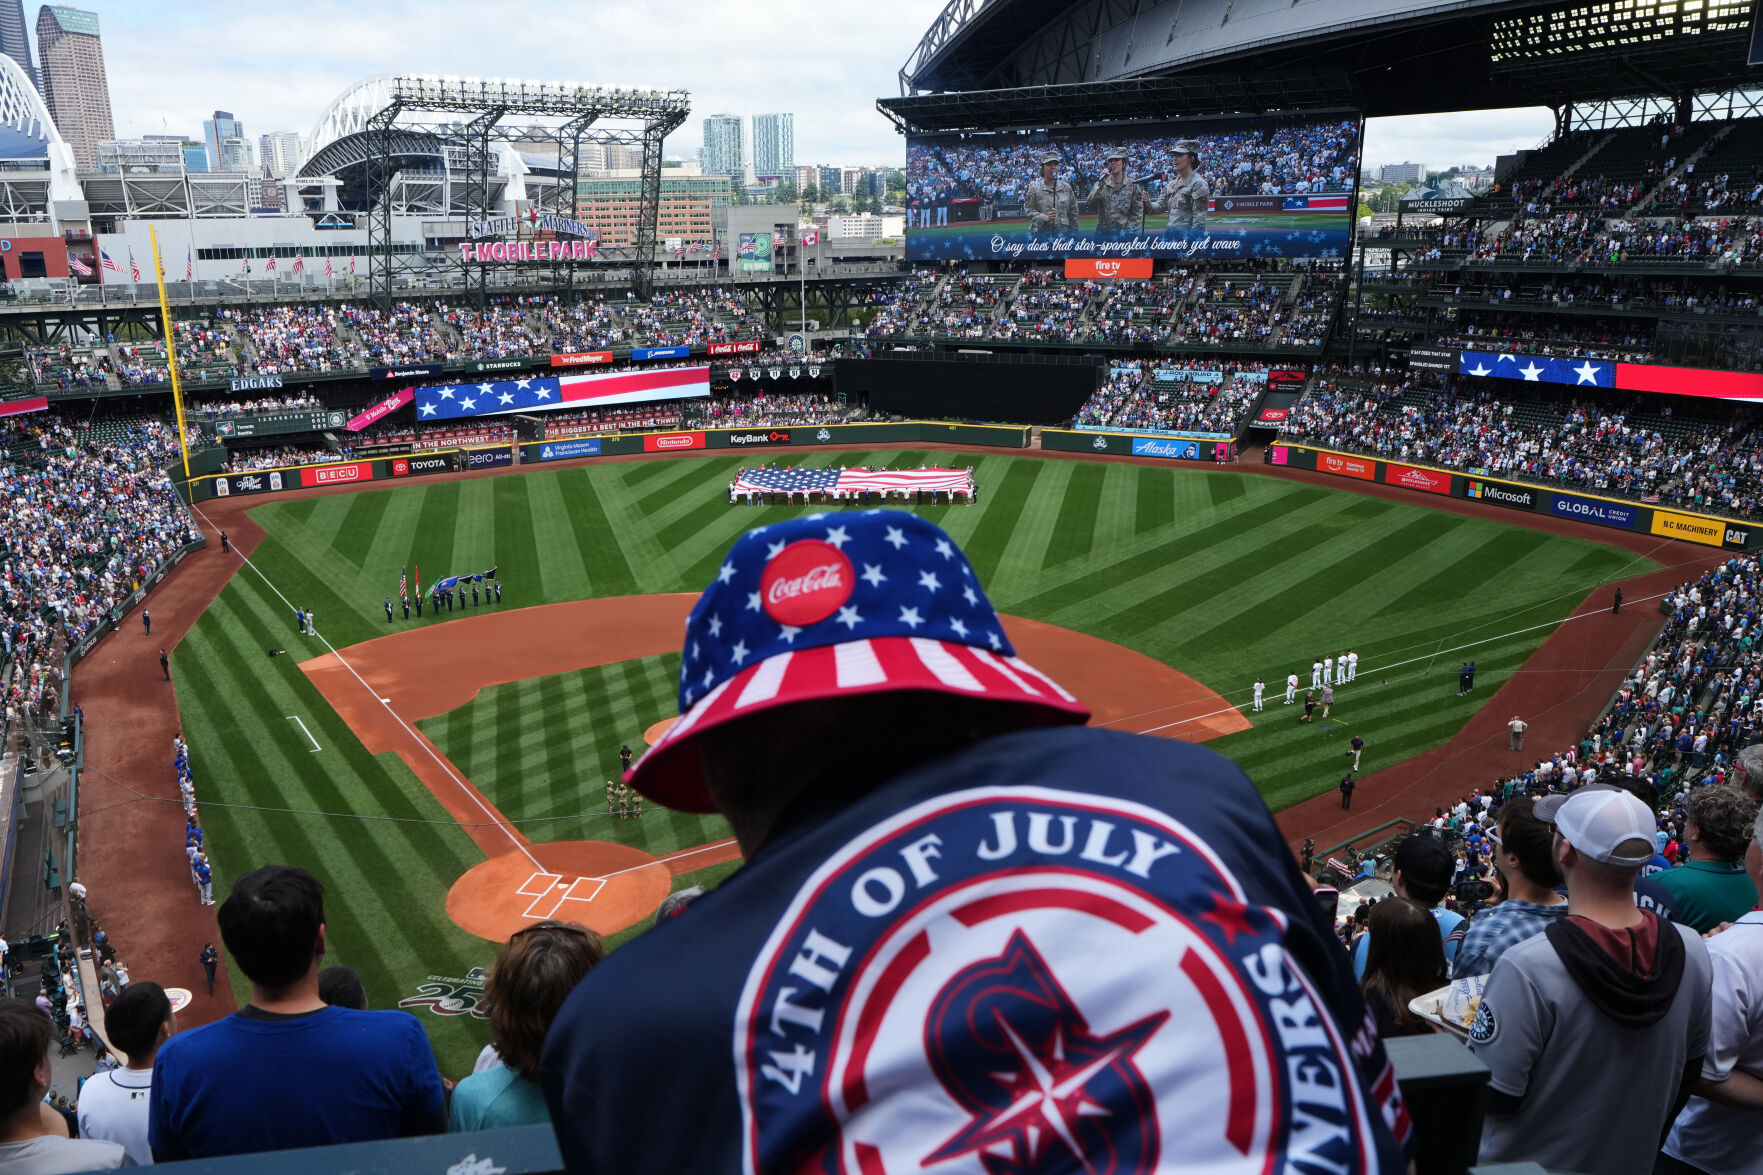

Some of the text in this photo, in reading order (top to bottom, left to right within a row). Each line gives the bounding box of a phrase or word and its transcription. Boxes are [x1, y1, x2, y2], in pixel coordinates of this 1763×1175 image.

[1408, 200, 1464, 208] MUCKLESHOOT
[473, 216, 517, 238] SEATTLE
[542, 214, 588, 237] MARINERS
[459, 240, 597, 262] T-MOBILE PARK
[991, 236, 1240, 257] O say does that star-spangled banner yet wave
[1096, 261, 1110, 270] fire
[232, 378, 282, 391] EDGARS
[561, 426, 590, 434] BIGGEST
[441, 436, 489, 447] NORTHWEST
[660, 438, 690, 446] Nintendo
[731, 434, 768, 444] KeyBank
[1136, 441, 1177, 456] Alaska
[411, 460, 445, 469] TOYOTA
[1326, 456, 1336, 466] fire
[1484, 487, 1531, 504] Microsoft
[1557, 501, 1605, 518] GLOBAL
[1676, 522, 1718, 536] MACHINERY
[1725, 530, 1748, 544] CAT
[768, 562, 844, 604] Coca-Cola
[761, 810, 1182, 1095] 4TH OF JULY
[427, 975, 483, 986] CELEBRATING
